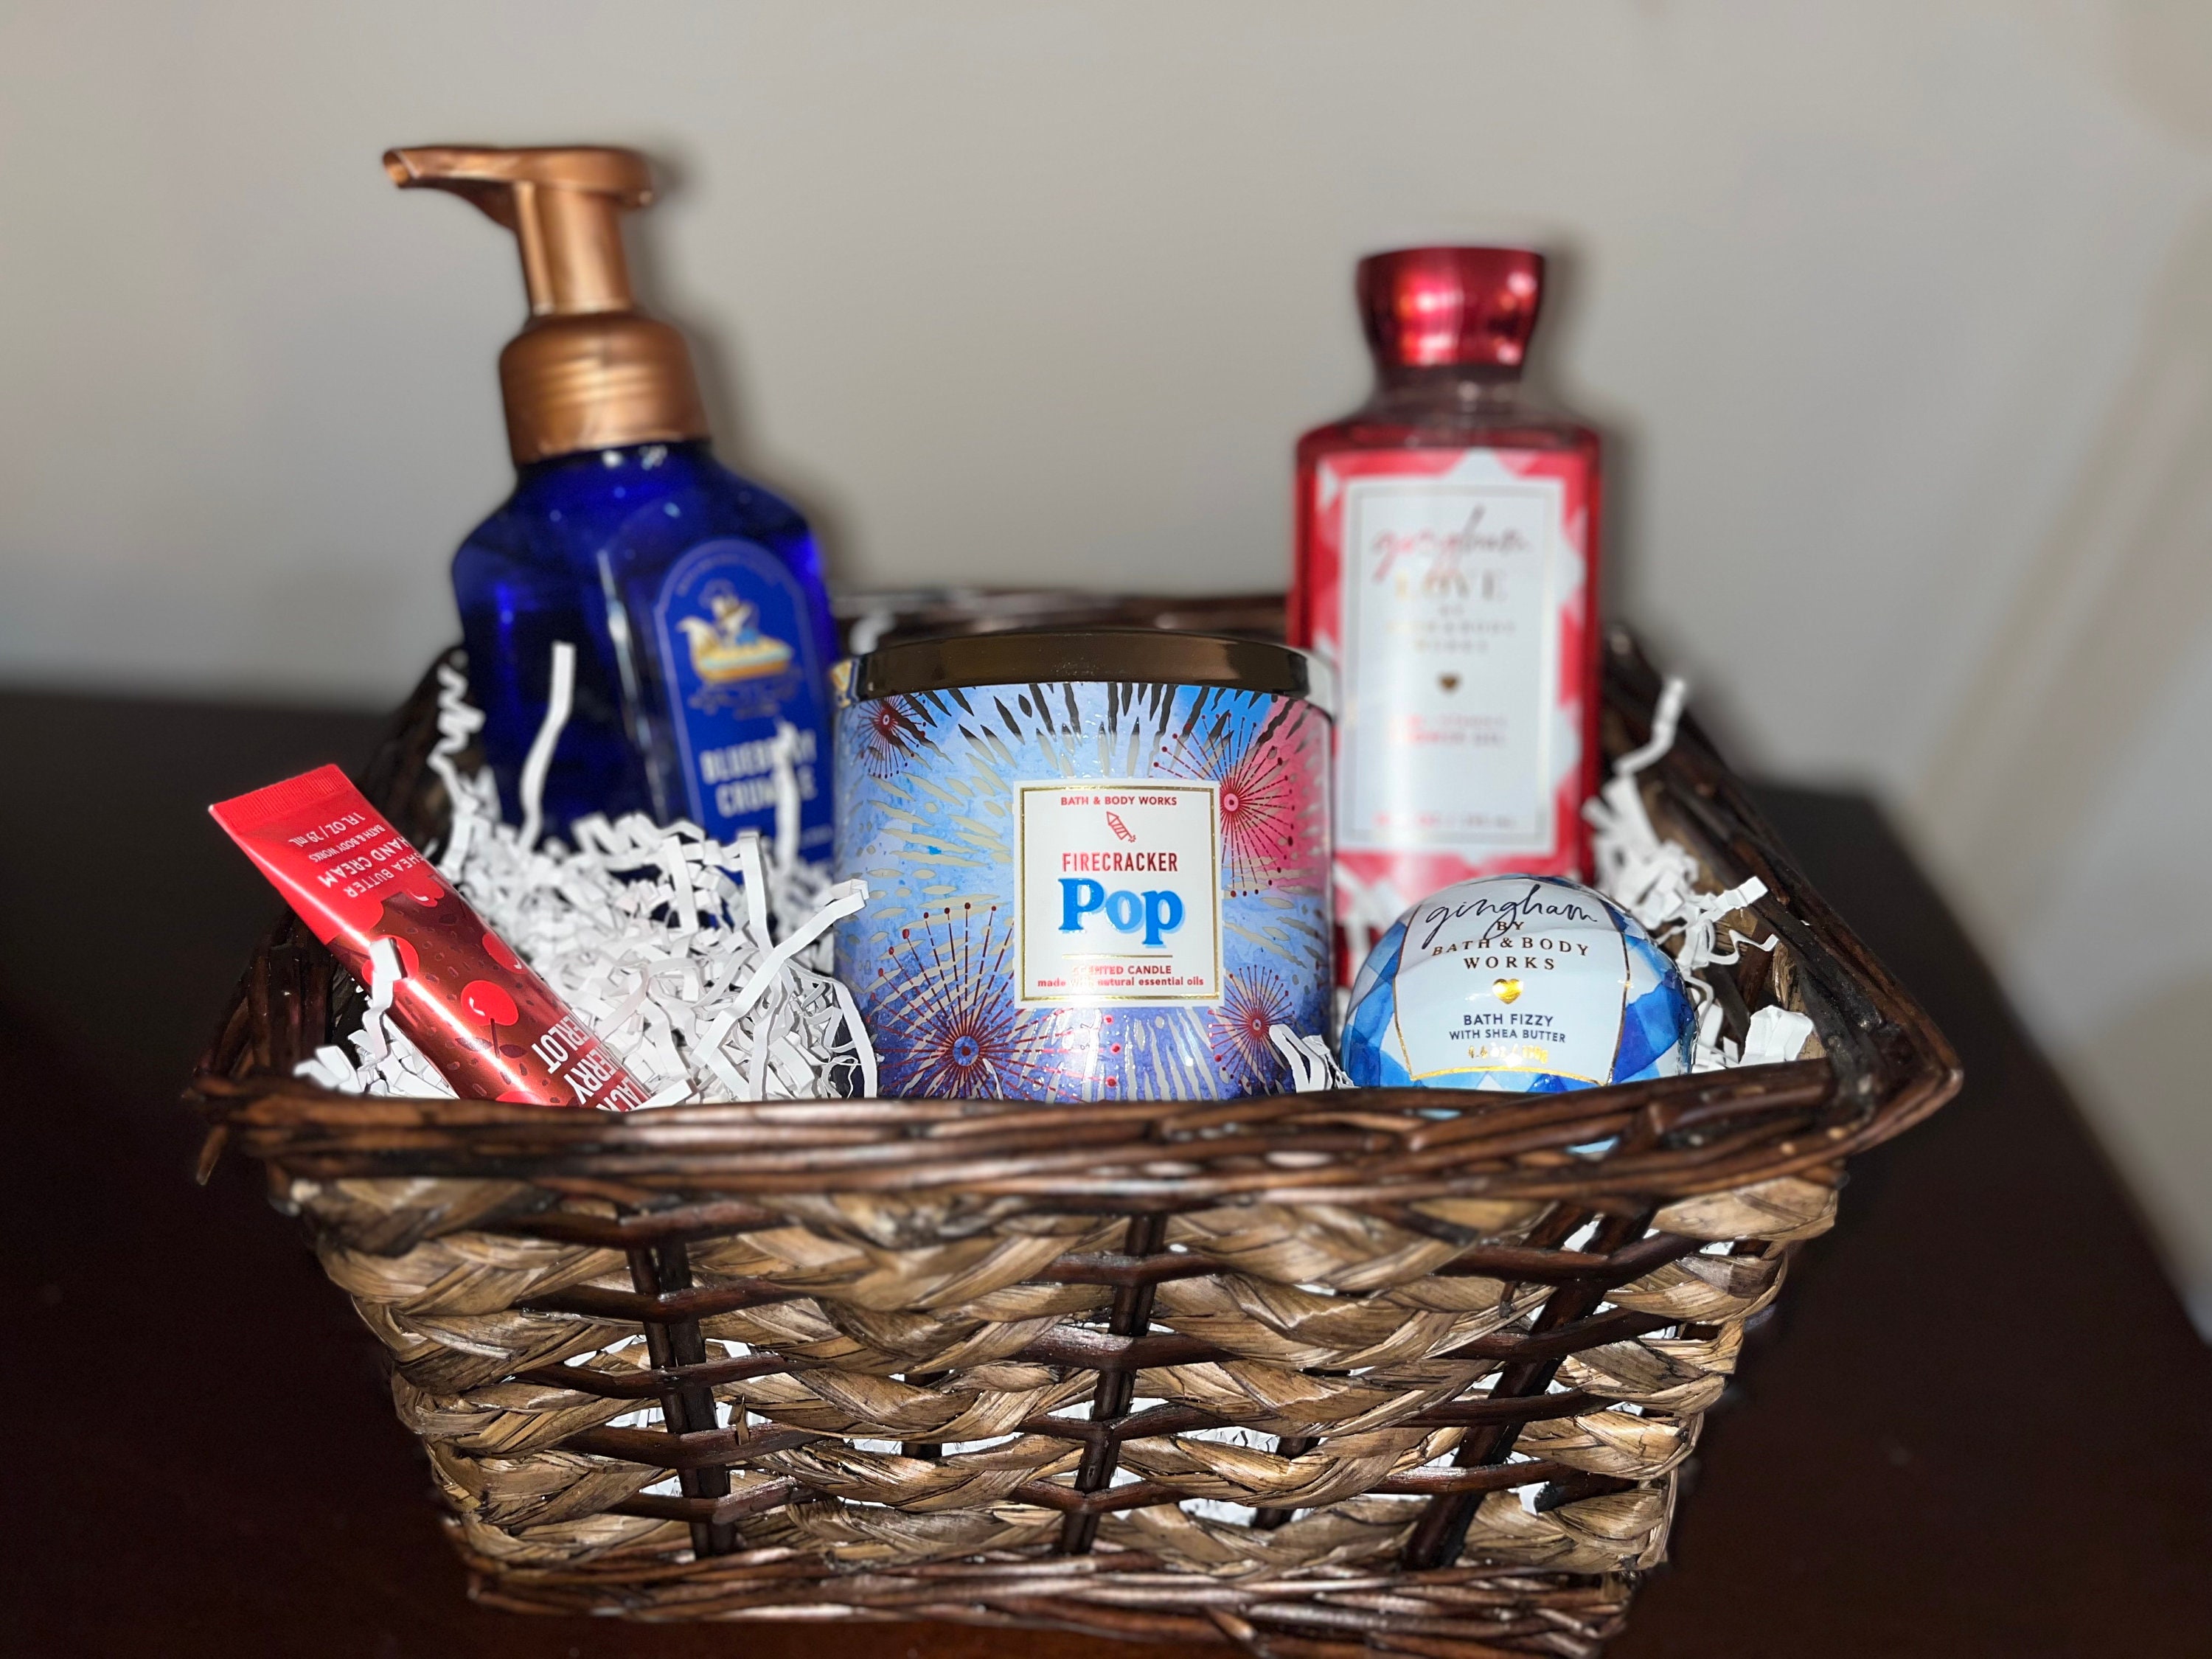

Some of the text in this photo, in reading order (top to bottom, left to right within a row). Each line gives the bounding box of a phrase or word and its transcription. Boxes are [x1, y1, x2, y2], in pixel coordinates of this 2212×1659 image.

[1060, 796, 1178, 806] BATH & BODY WORKS
[325, 821, 347, 835] OZ
[341, 815, 360, 826] FL
[306, 831, 324, 843] 29
[364, 824, 386, 839] BATH
[338, 838, 361, 853] BODY
[308, 846, 341, 863] WORKS
[317, 836, 409, 888] HAND CREAM
[1062, 852, 1178, 872] FIRECRACKER
[343, 852, 425, 898] SHEA BUTTER
[1058, 877, 1186, 949] Pop
[1422, 884, 1598, 950] gingham
[1497, 921, 1524, 931] BY
[1432, 936, 1589, 956] BATH & BODY
[1127, 965, 1172, 975] CANDLE
[1464, 956, 1555, 970] WORKS
[1037, 977, 1066, 987] made
[1097, 976, 1135, 987] natural
[1138, 976, 1183, 986] essential
[1187, 975, 1204, 986] oils
[1463, 1014, 1554, 1027] BATH FIZZY
[531, 1013, 592, 1074] ERLOT
[1449, 1029, 1566, 1043] WITH SHEA BUTTER
[563, 1043, 622, 1105] HERRY
